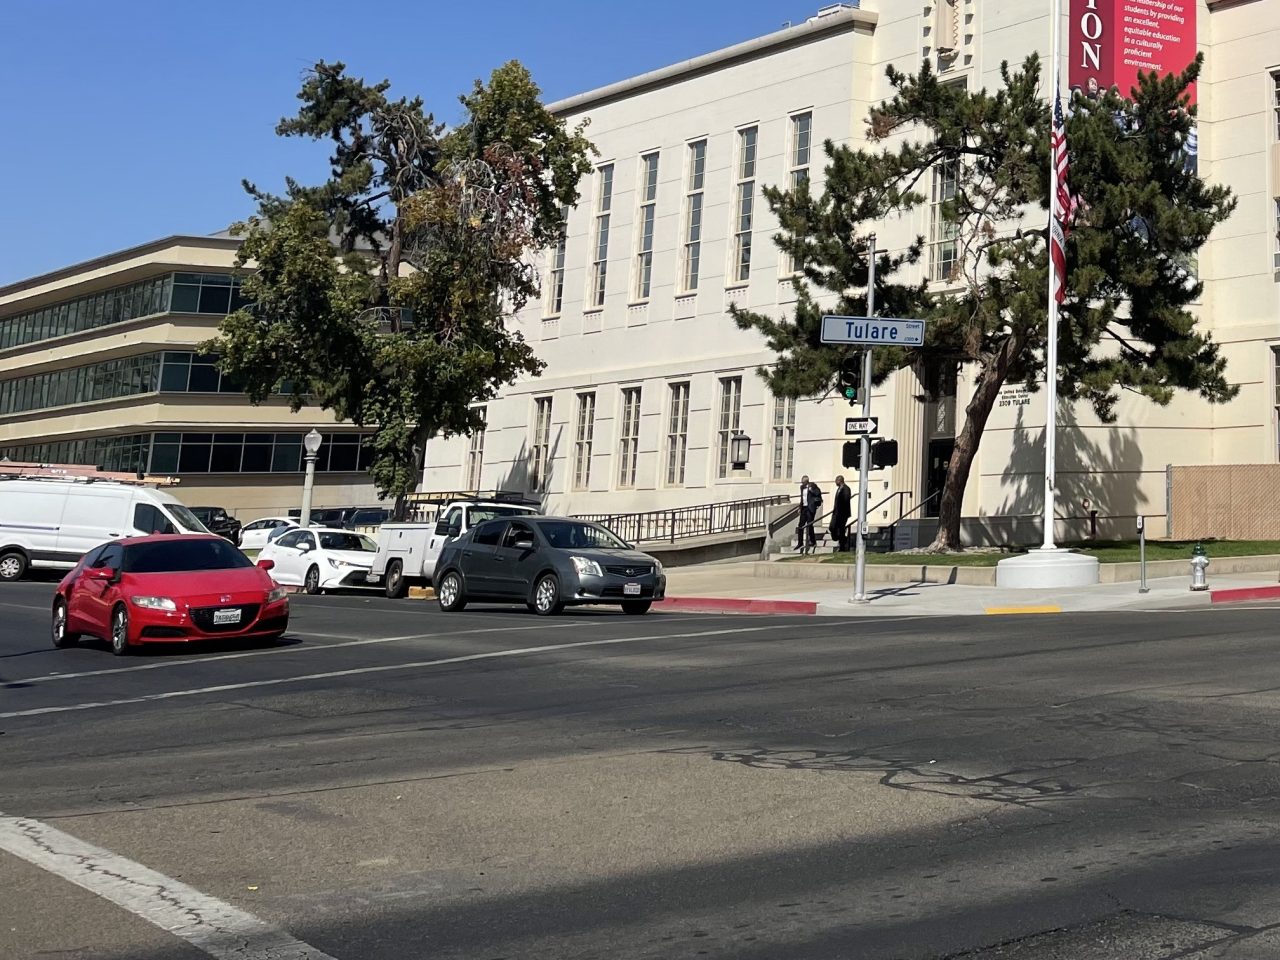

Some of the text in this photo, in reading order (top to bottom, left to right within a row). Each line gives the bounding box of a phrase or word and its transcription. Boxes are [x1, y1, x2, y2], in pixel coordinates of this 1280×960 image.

[1124, 5, 1185, 24] students by providing
[1124, 26, 1181, 43] equitable education
[1124, 35, 1130, 44] in
[1135, 38, 1163, 51] culturally
[1124, 47, 1153, 58] proficient
[846, 322, 898, 339] Tulare
[848, 422, 868, 430] ONE WAY
